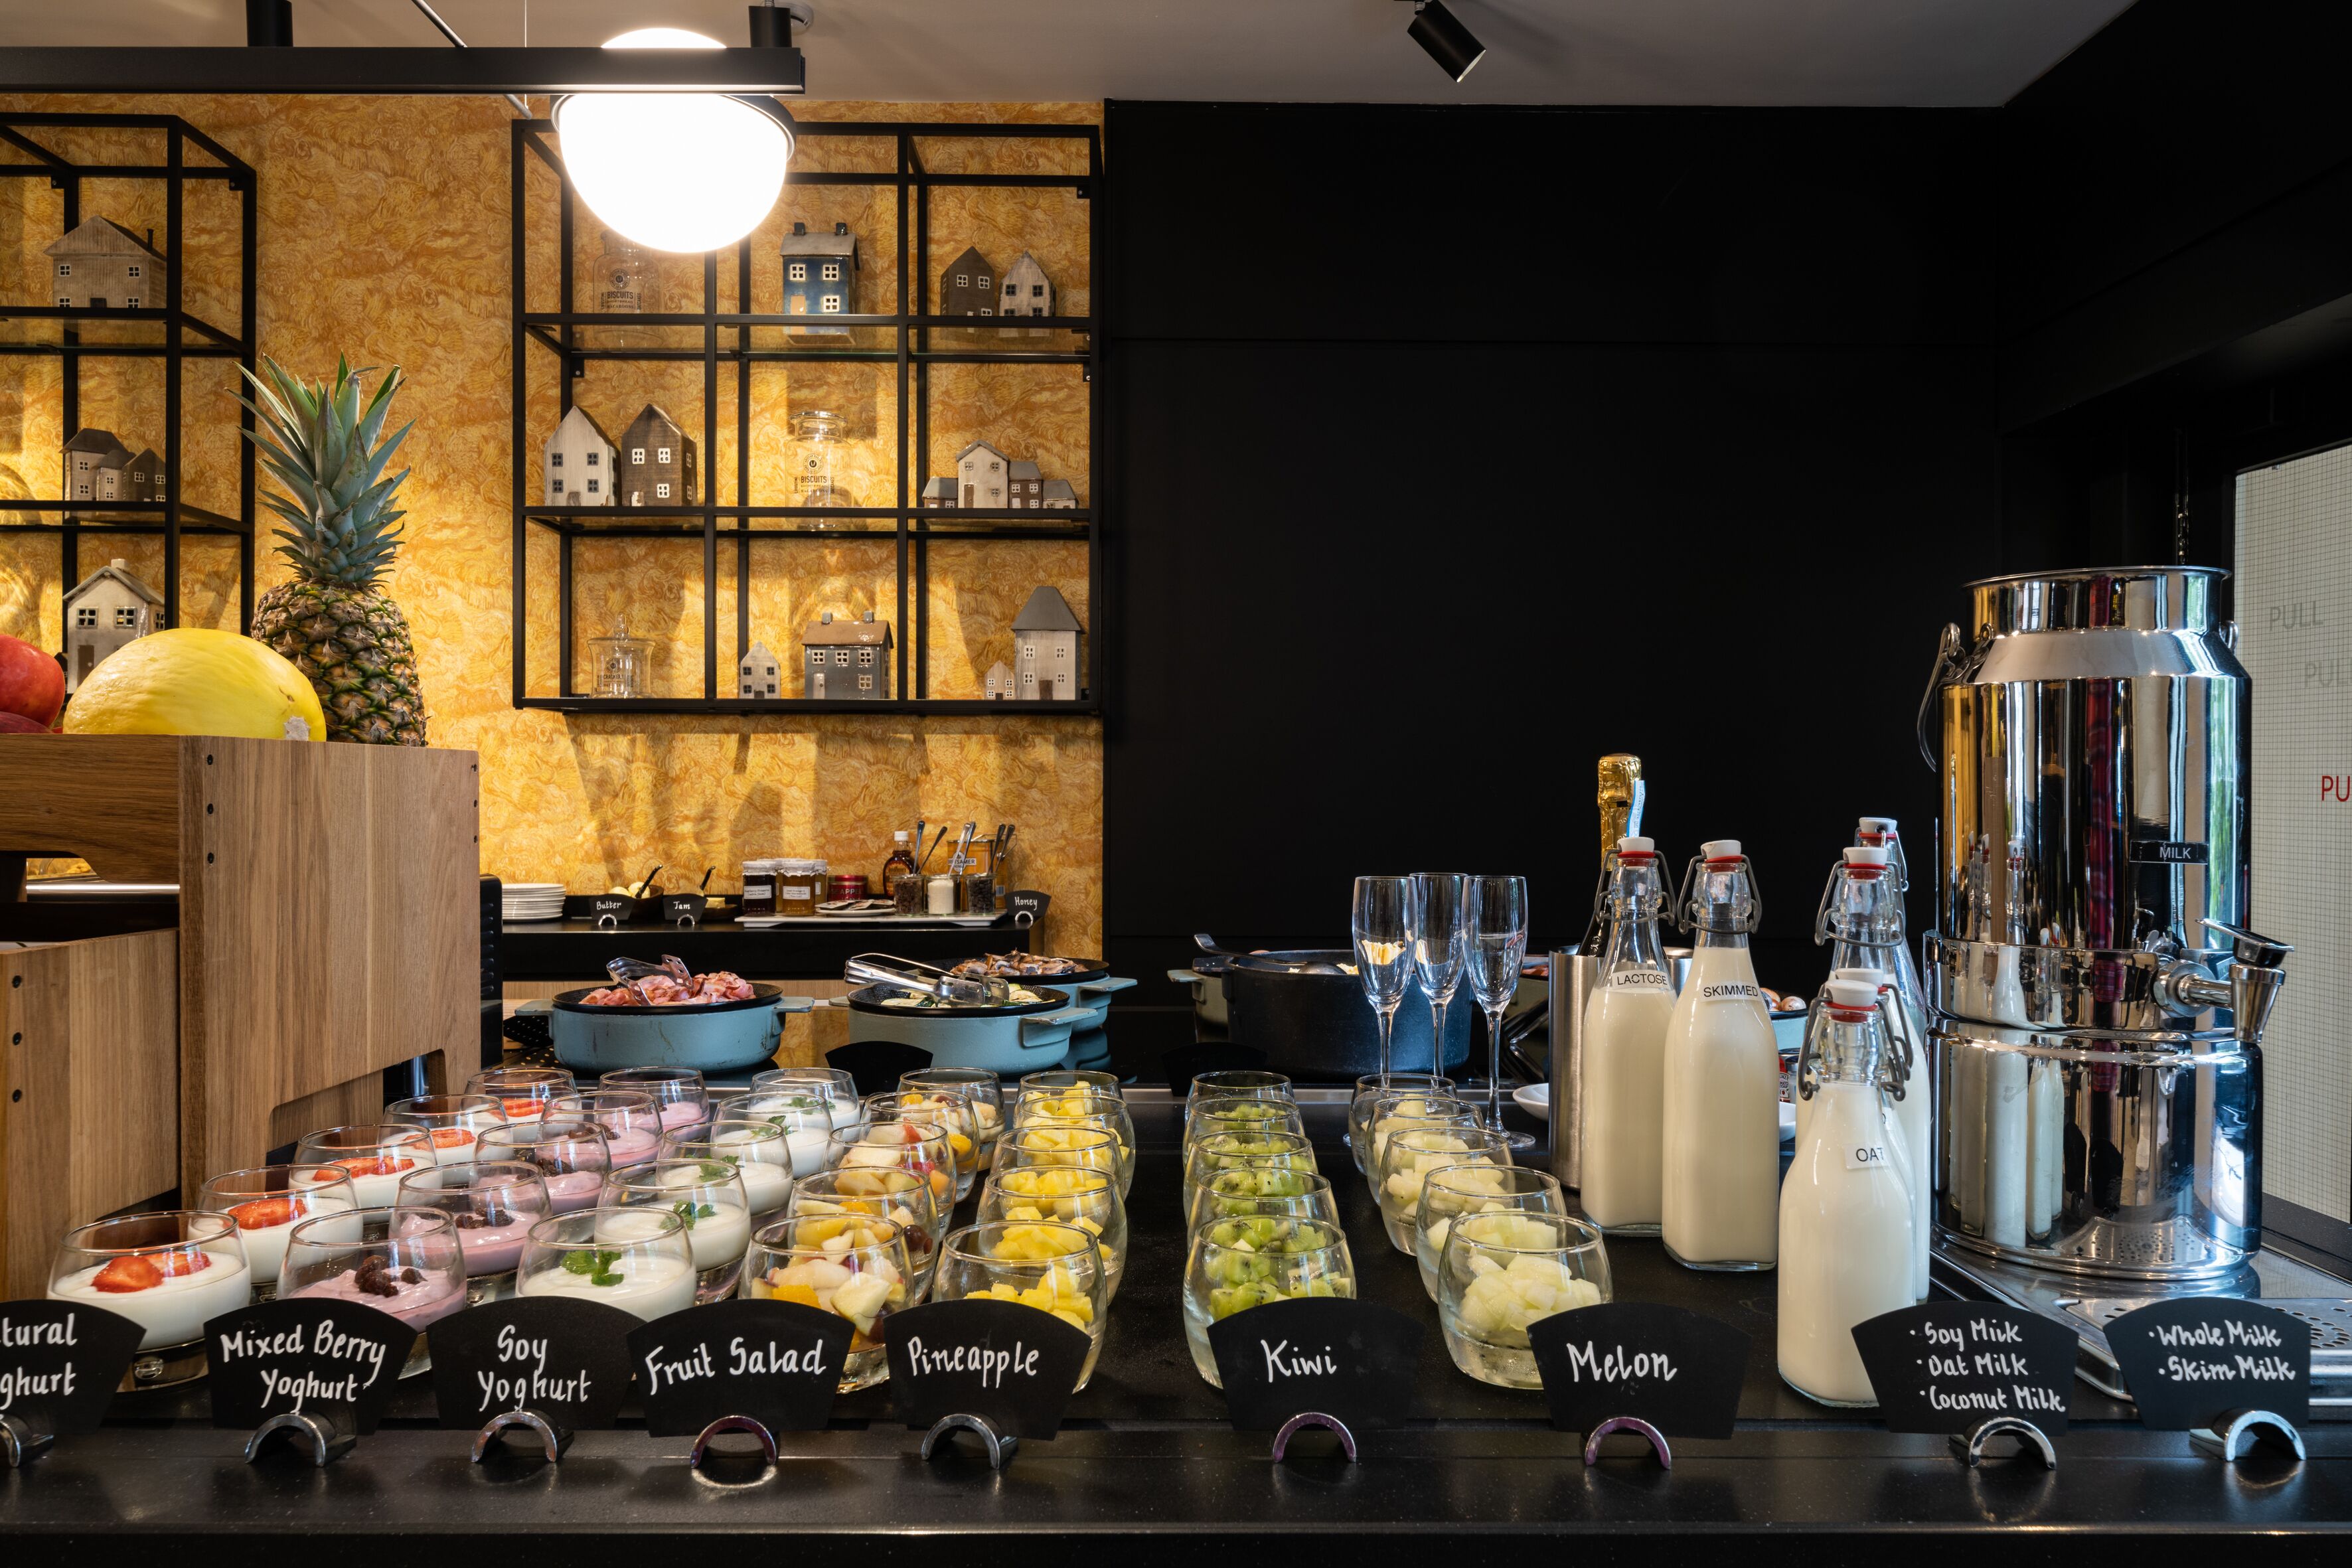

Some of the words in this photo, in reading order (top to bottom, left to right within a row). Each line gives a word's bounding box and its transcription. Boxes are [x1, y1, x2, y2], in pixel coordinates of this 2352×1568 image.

[607, 291, 634, 299] BISCUITS
[2269, 600, 2324, 631] PULL
[2304, 658, 2352, 688] PUL
[2321, 775, 2351, 802] PU
[2159, 846, 2191, 859] MILK
[596, 901, 622, 910] Butter
[672, 901, 691, 910] Jam
[1014, 896, 1038, 911] Honey
[1617, 973, 1668, 985] LACTOSE
[1703, 985, 1759, 997] SKIMMED
[1856, 1147, 1885, 1162] OAT
[0, 1312, 78, 1347] tural
[1924, 1321, 1964, 1352] Soy
[1970, 1318, 2023, 1343] Milk
[2156, 1322, 2224, 1346] Whole
[2225, 1319, 2282, 1348] Milk
[220, 1324, 304, 1362] Mixed
[313, 1319, 386, 1391] Berry
[497, 1324, 548, 1372] Soy
[907, 1336, 1040, 1389] Pineapple
[1261, 1339, 1337, 1383] Kiwi
[1566, 1340, 1678, 1382] Melon
[645, 1342, 716, 1395] Fruit
[729, 1336, 827, 1375] Salad
[1928, 1355, 1969, 1376] Oat
[1974, 1352, 2029, 1376] Milk
[2167, 1355, 2236, 1381] Skim
[2236, 1355, 2296, 1381] Milk
[261, 1369, 357, 1415] Yoghurt
[477, 1369, 591, 1413] Yoghurt
[1929, 1385, 2007, 1410] Coconut
[2012, 1385, 2066, 1412] Milk
